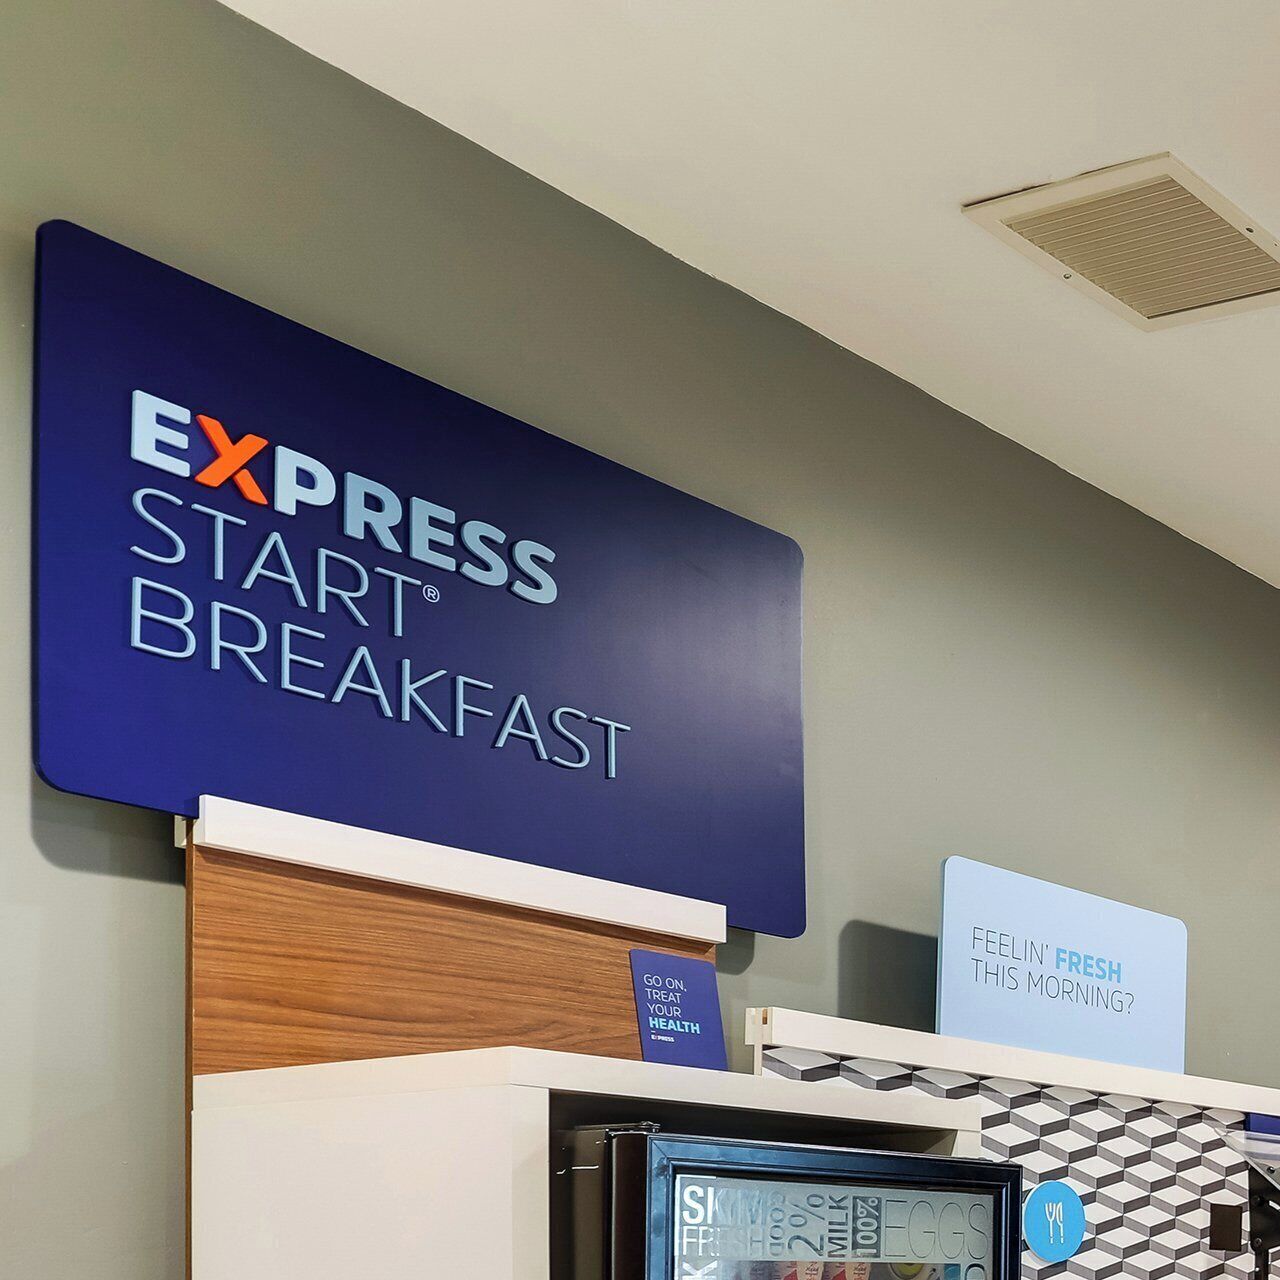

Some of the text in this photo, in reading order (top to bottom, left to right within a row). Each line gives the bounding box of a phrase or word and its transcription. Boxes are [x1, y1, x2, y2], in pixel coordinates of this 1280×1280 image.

[131, 389, 559, 605] EXPRESS
[131, 576, 631, 779] BREAKFAST
[643, 974, 662, 987] GO
[971, 957, 1135, 1014] THIS MORNING?
[1055, 947, 1122, 983] FRESH
[645, 988, 681, 1003] TREAT
[647, 1003, 681, 1018] YOUR
[649, 1016, 700, 1034] HEALTH
[828, 1194, 849, 1258] MILK
[885, 1200, 989, 1260] EGGS
